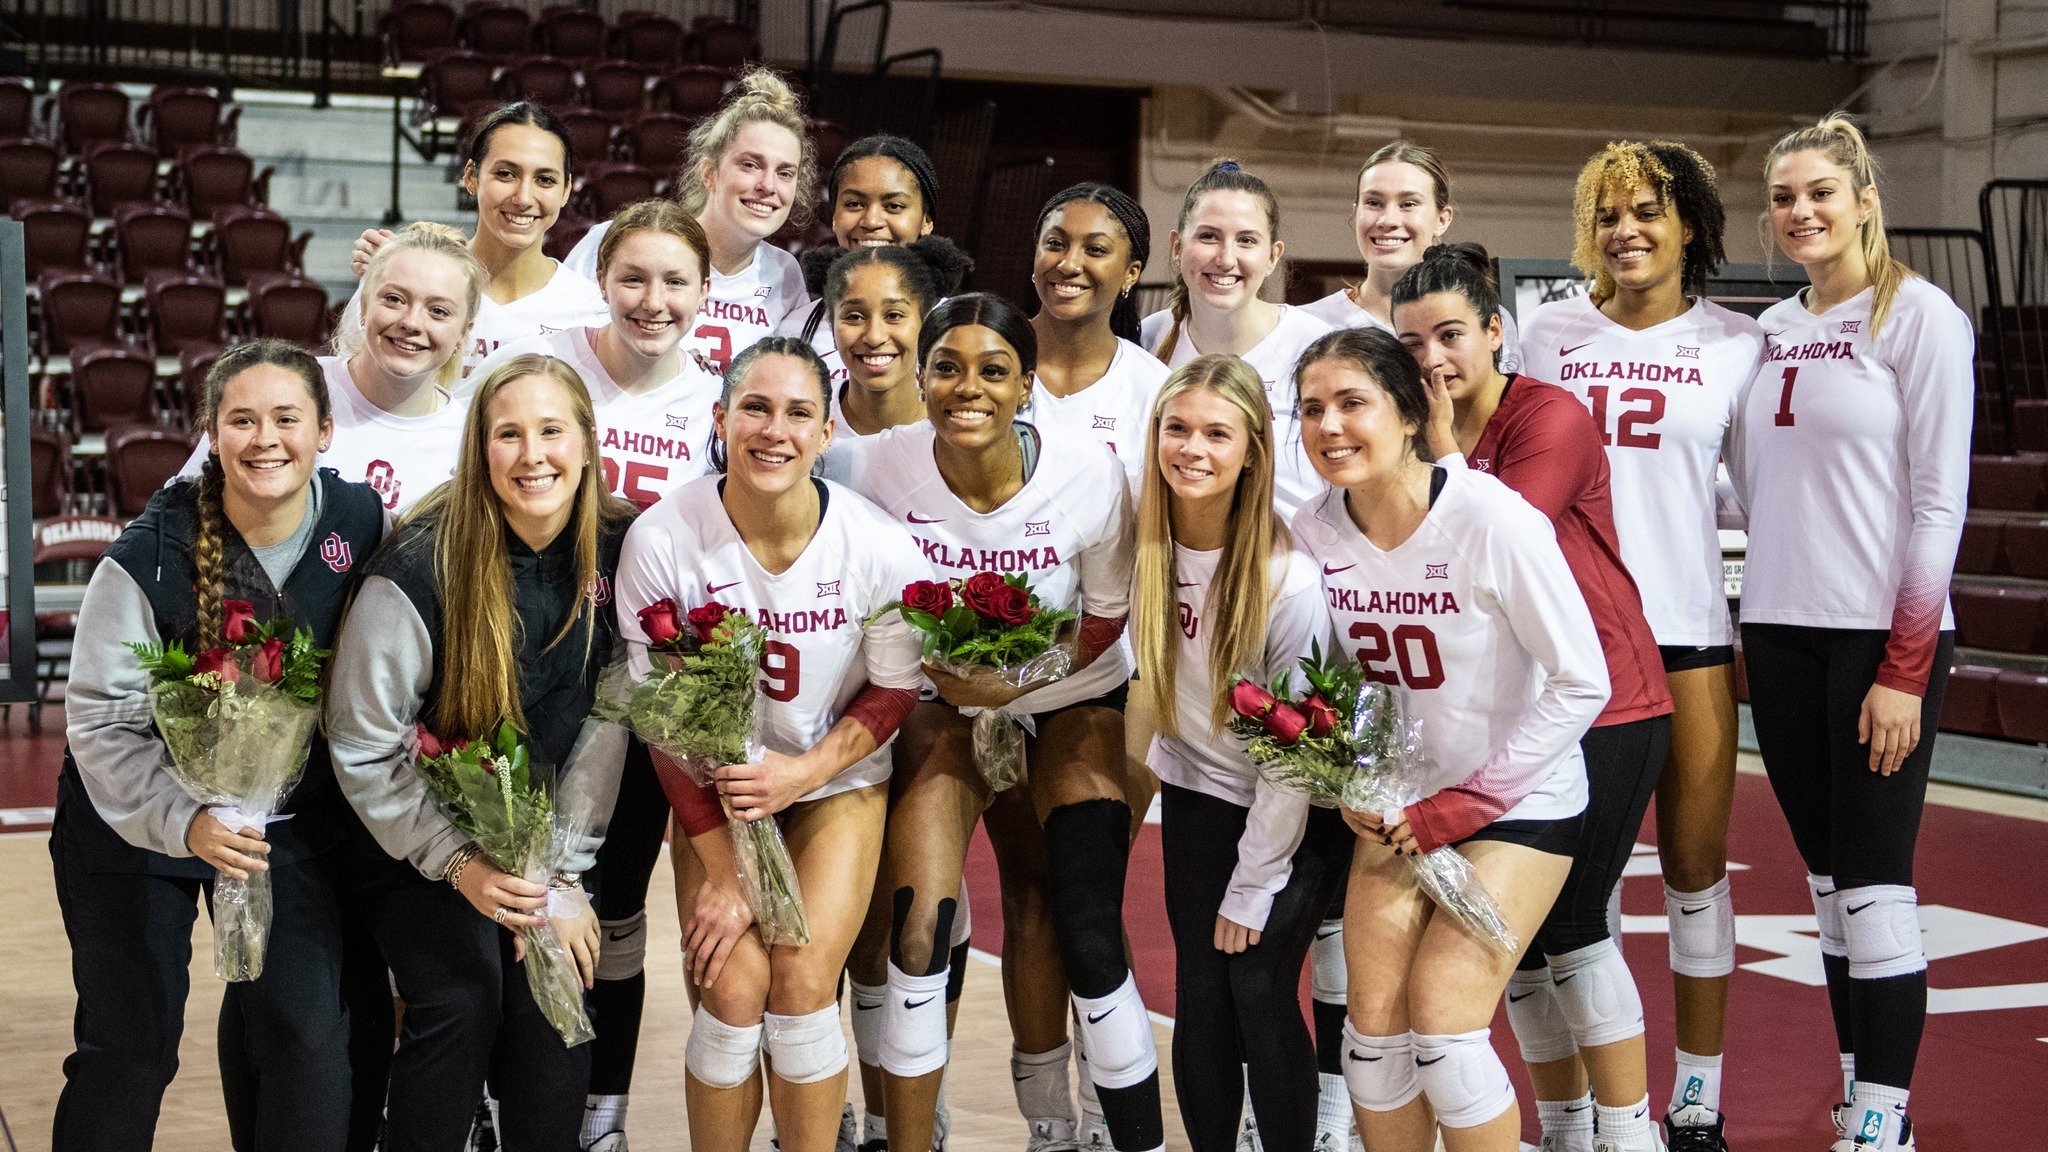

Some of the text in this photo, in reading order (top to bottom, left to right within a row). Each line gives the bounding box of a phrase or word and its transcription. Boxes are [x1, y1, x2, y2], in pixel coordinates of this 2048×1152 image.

[696, 297, 770, 327] AHOMA
[694, 324, 732, 372] 3
[1765, 341, 1854, 362] KLAHOMA
[1560, 361, 1704, 386] OKLAHOMA
[1587, 385, 1666, 450] 12
[1774, 366, 1800, 427] 1
[599, 427, 691, 461] AHOMA
[365, 459, 402, 510] OU
[320, 531, 353, 573] OU
[911, 535, 1061, 572] KLAHOMA
[759, 640, 800, 703] 9
[1348, 621, 1446, 691] 20
